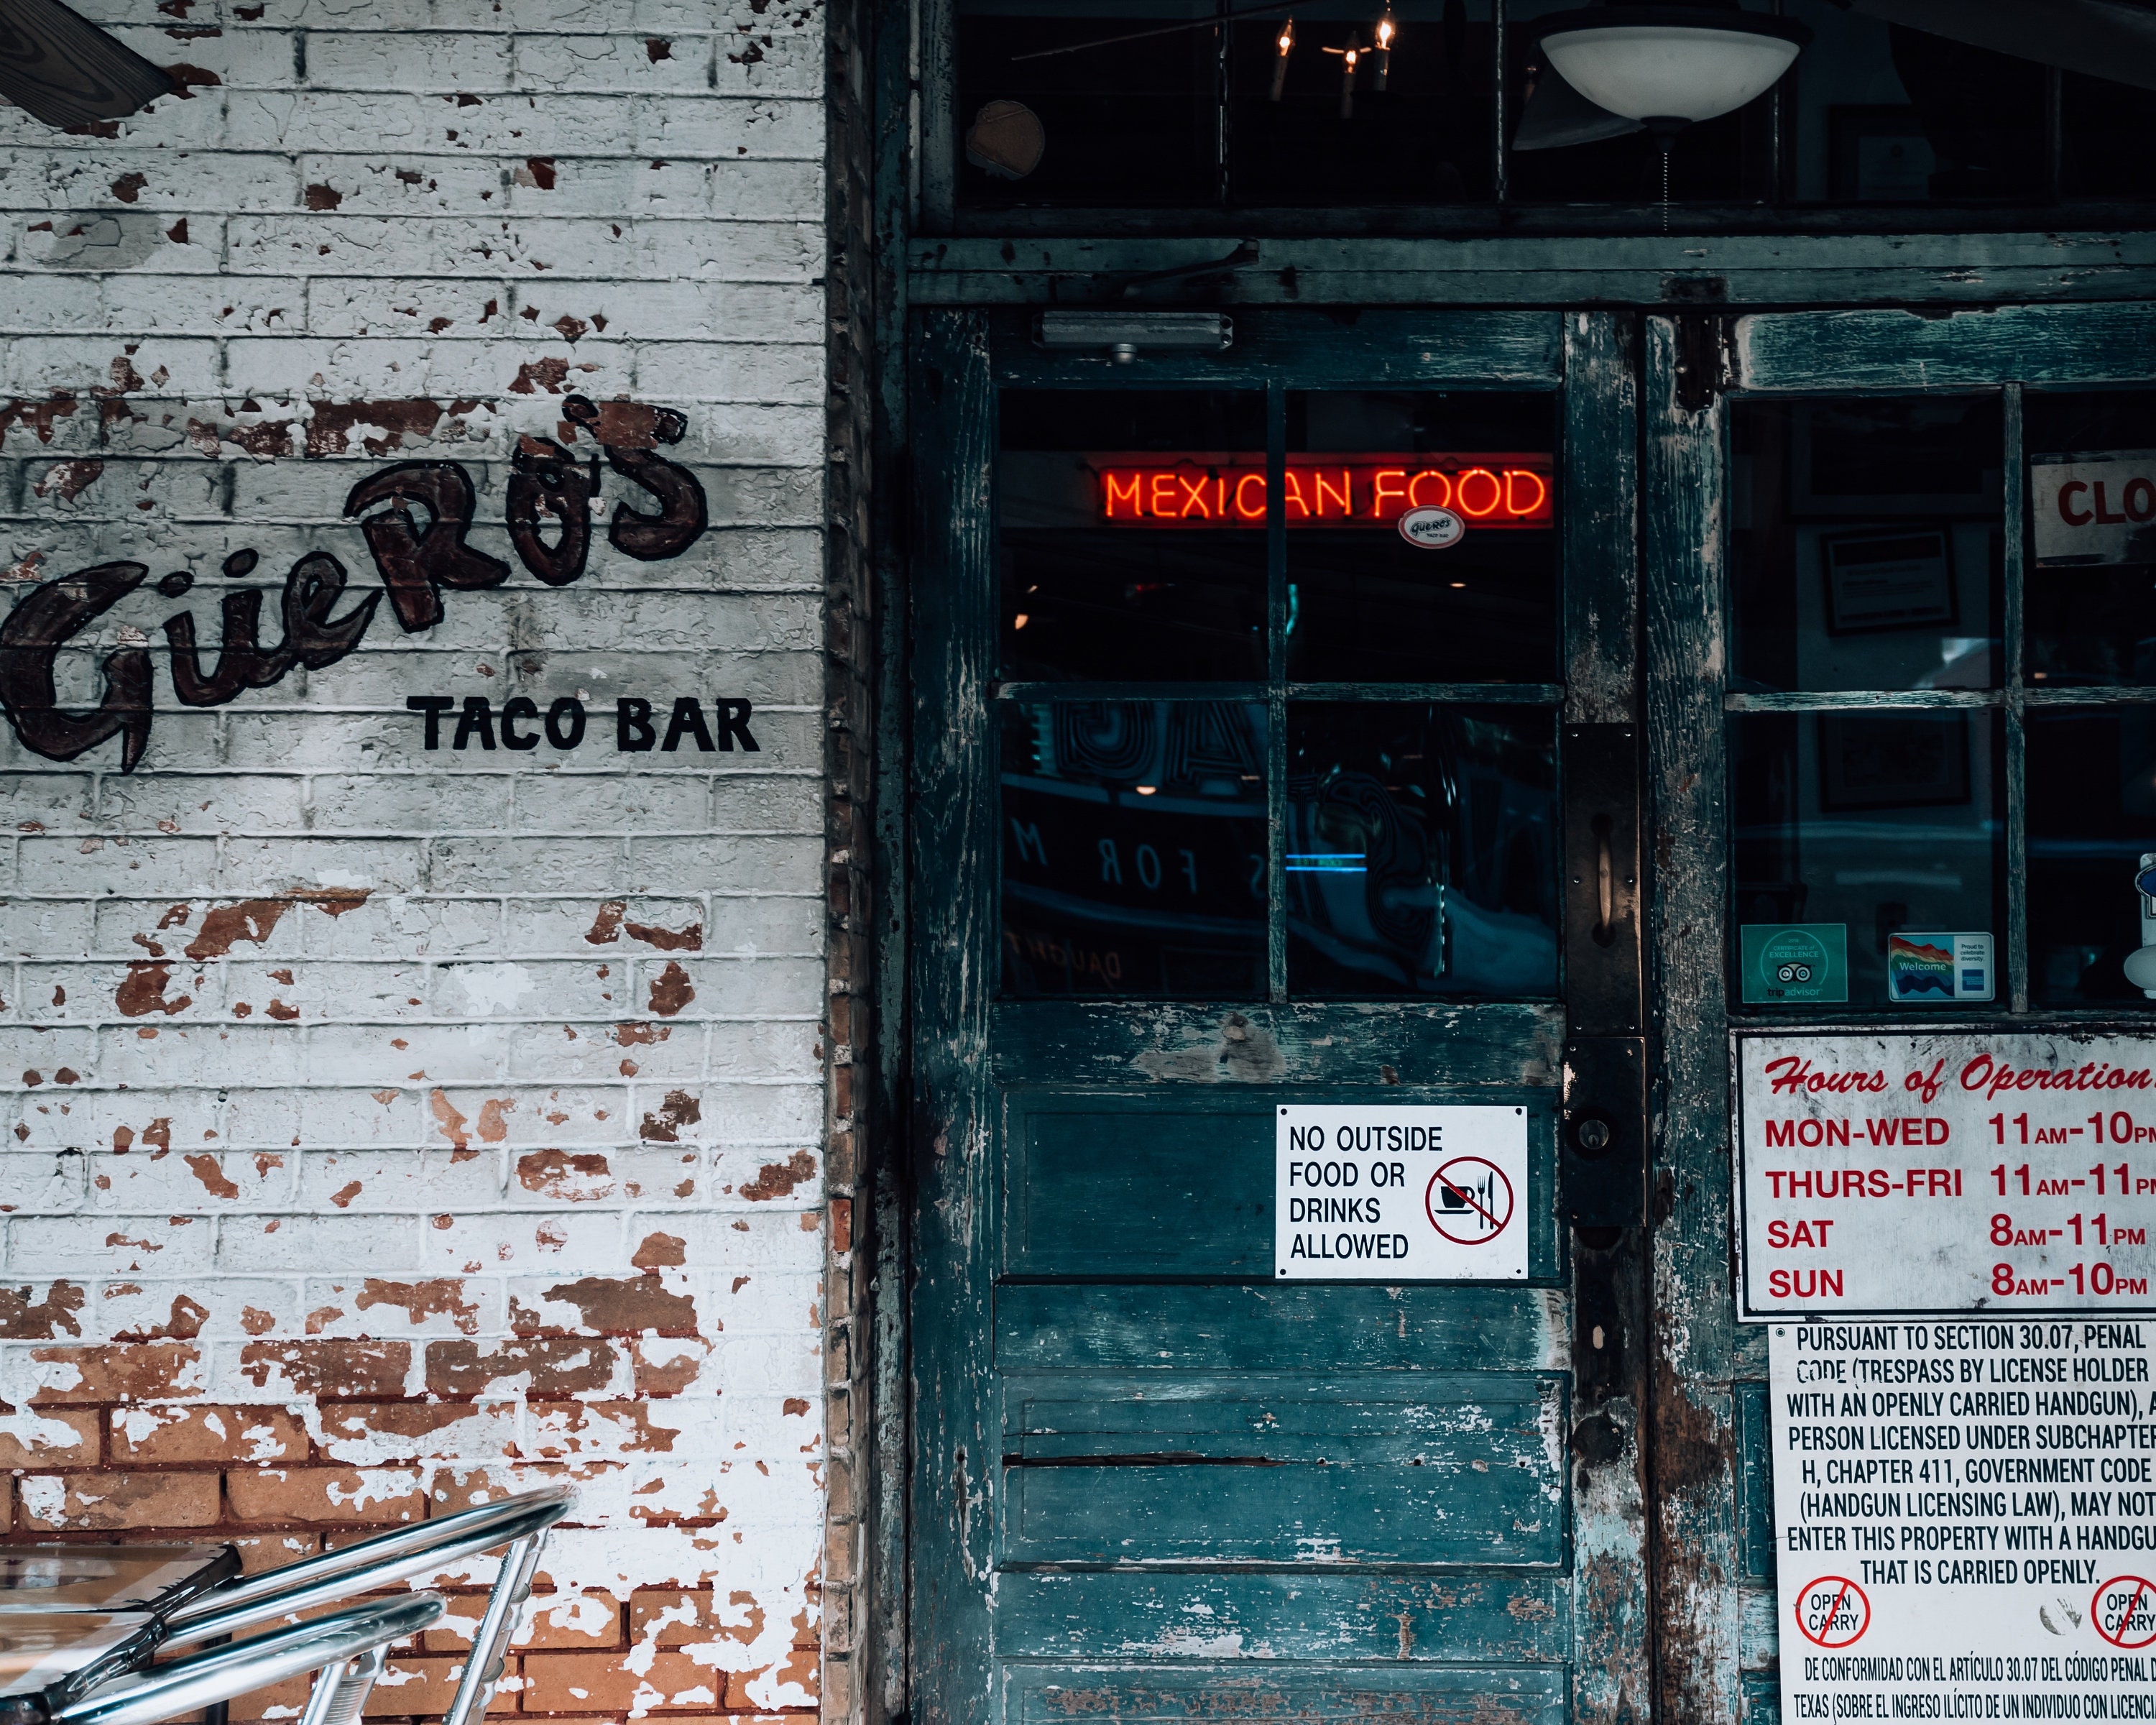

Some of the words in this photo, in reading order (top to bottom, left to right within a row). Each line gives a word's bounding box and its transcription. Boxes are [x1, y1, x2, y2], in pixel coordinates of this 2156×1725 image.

[1105, 471, 1351, 518] MEXICAN
[1373, 469, 1545, 518] FOOD
[2058, 478, 2156, 526] CLO
[407, 696, 586, 750] TACO
[617, 696, 760, 752] BAR
[1767, 988, 1820, 998] tripadvisor
[1765, 1057, 1887, 1094] Hours
[1905, 1059, 1944, 1103] of
[1291, 1126, 1325, 1151] NO
[1337, 1126, 1442, 1151] OUTSIDE
[1766, 1118, 1949, 1147] MON-WED
[1291, 1162, 1358, 1187] FOOD
[1371, 1162, 1404, 1187] OR
[1765, 1169, 1961, 1198] THURS-FRI
[1991, 1164, 2156, 1196] 11AM-11P
[1291, 1197, 1380, 1223] DRINKS
[1291, 1233, 1408, 1259] ALLOWED
[1768, 1220, 1833, 1248] SAT
[1769, 1269, 1843, 1298] SUN
[1797, 1326, 1898, 1351] PURSUANT
[1904, 1326, 1927, 1350] TO
[1935, 1325, 2013, 1350] SECTION
[2020, 1325, 2078, 1353] 30.07,
[2085, 1325, 2146, 1348] PENAL
[1797, 1360, 1846, 1383] CODE
[1961, 1359, 1984, 1382] BY
[1991, 1358, 2067, 1382] LICENSE
[2073, 1358, 2149, 1381] HOLDER
[1787, 1394, 1834, 1417] WITH
[1841, 1393, 1866, 1417] AN
[1873, 1392, 1943, 1417] OPENLY
[1950, 1392, 2030, 1416] CARRIED
[2036, 1389, 2142, 1422] HANDGUN),
[1789, 1426, 1864, 1450] PERSON
[1871, 1426, 1960, 1450] LICENSED
[1967, 1425, 2030, 1449] UNDER
[1802, 1460, 1820, 1488] H,
[1828, 1460, 1913, 1484] CHAPTER
[1920, 1459, 1959, 1487] 411,
[1966, 1458, 2094, 1483] GOVERNMENT
[2101, 1458, 2152, 1482] CODE
[1801, 1491, 1900, 1524] (HANDGUN
[1907, 1492, 2006, 1517] LICENSING
[2013, 1490, 2065, 1523] LAW),
[2071, 1492, 2111, 1516] MAY
[2118, 1492, 2156, 1516] NOT
[1788, 1527, 1846, 1550] ENTER
[1852, 1527, 1894, 1550] THIS
[1902, 1527, 1999, 1550] PROPERTY
[2004, 1526, 2053, 1550] WITH
[2059, 1526, 2071, 1550] A
[2077, 1526, 2156, 1550] HANDGU
[1861, 1560, 1908, 1583] THAT
[1915, 1560, 1931, 1584] IS
[1938, 1560, 2017, 1584] CARRIED
[2024, 1560, 2099, 1583] OPENLY.
[1811, 1594, 1850, 1610] OPEN
[2107, 1594, 2147, 1611] OPEN
[1810, 1614, 1858, 1630] CARRY
[2105, 1614, 2155, 1631] CARRY
[1805, 1657, 1819, 1680] DE
[1823, 1657, 1903, 1680] CONFORMIDAD
[1907, 1657, 1930, 1680] CON
[1933, 1657, 1946, 1680] EL
[1950, 1651, 2003, 1681] ARTÍCULO
[2007, 1657, 2037, 1681] 30.07
[2042, 1657, 2062, 1680] DEL
[2065, 1651, 2107, 1681] CÓDIGO
[2111, 1657, 2148, 1681] PENAL
[1794, 1694, 1828, 1718] TEXAS
[1833, 1693, 1873, 1725] (SOBRE
[1876, 1695, 1889, 1717] EL
[1892, 1694, 1940, 1718] INGRESO
[1944, 1688, 1982, 1718] ILÍCITO
[1986, 1695, 1999, 1718] DE
[2003, 1695, 2019, 1718] UN
[2022, 1695, 2080, 1719] INDIVIDUO
[2084, 1695, 2107, 1719] CON
[2111, 1695, 2156, 1719] LICENCI
